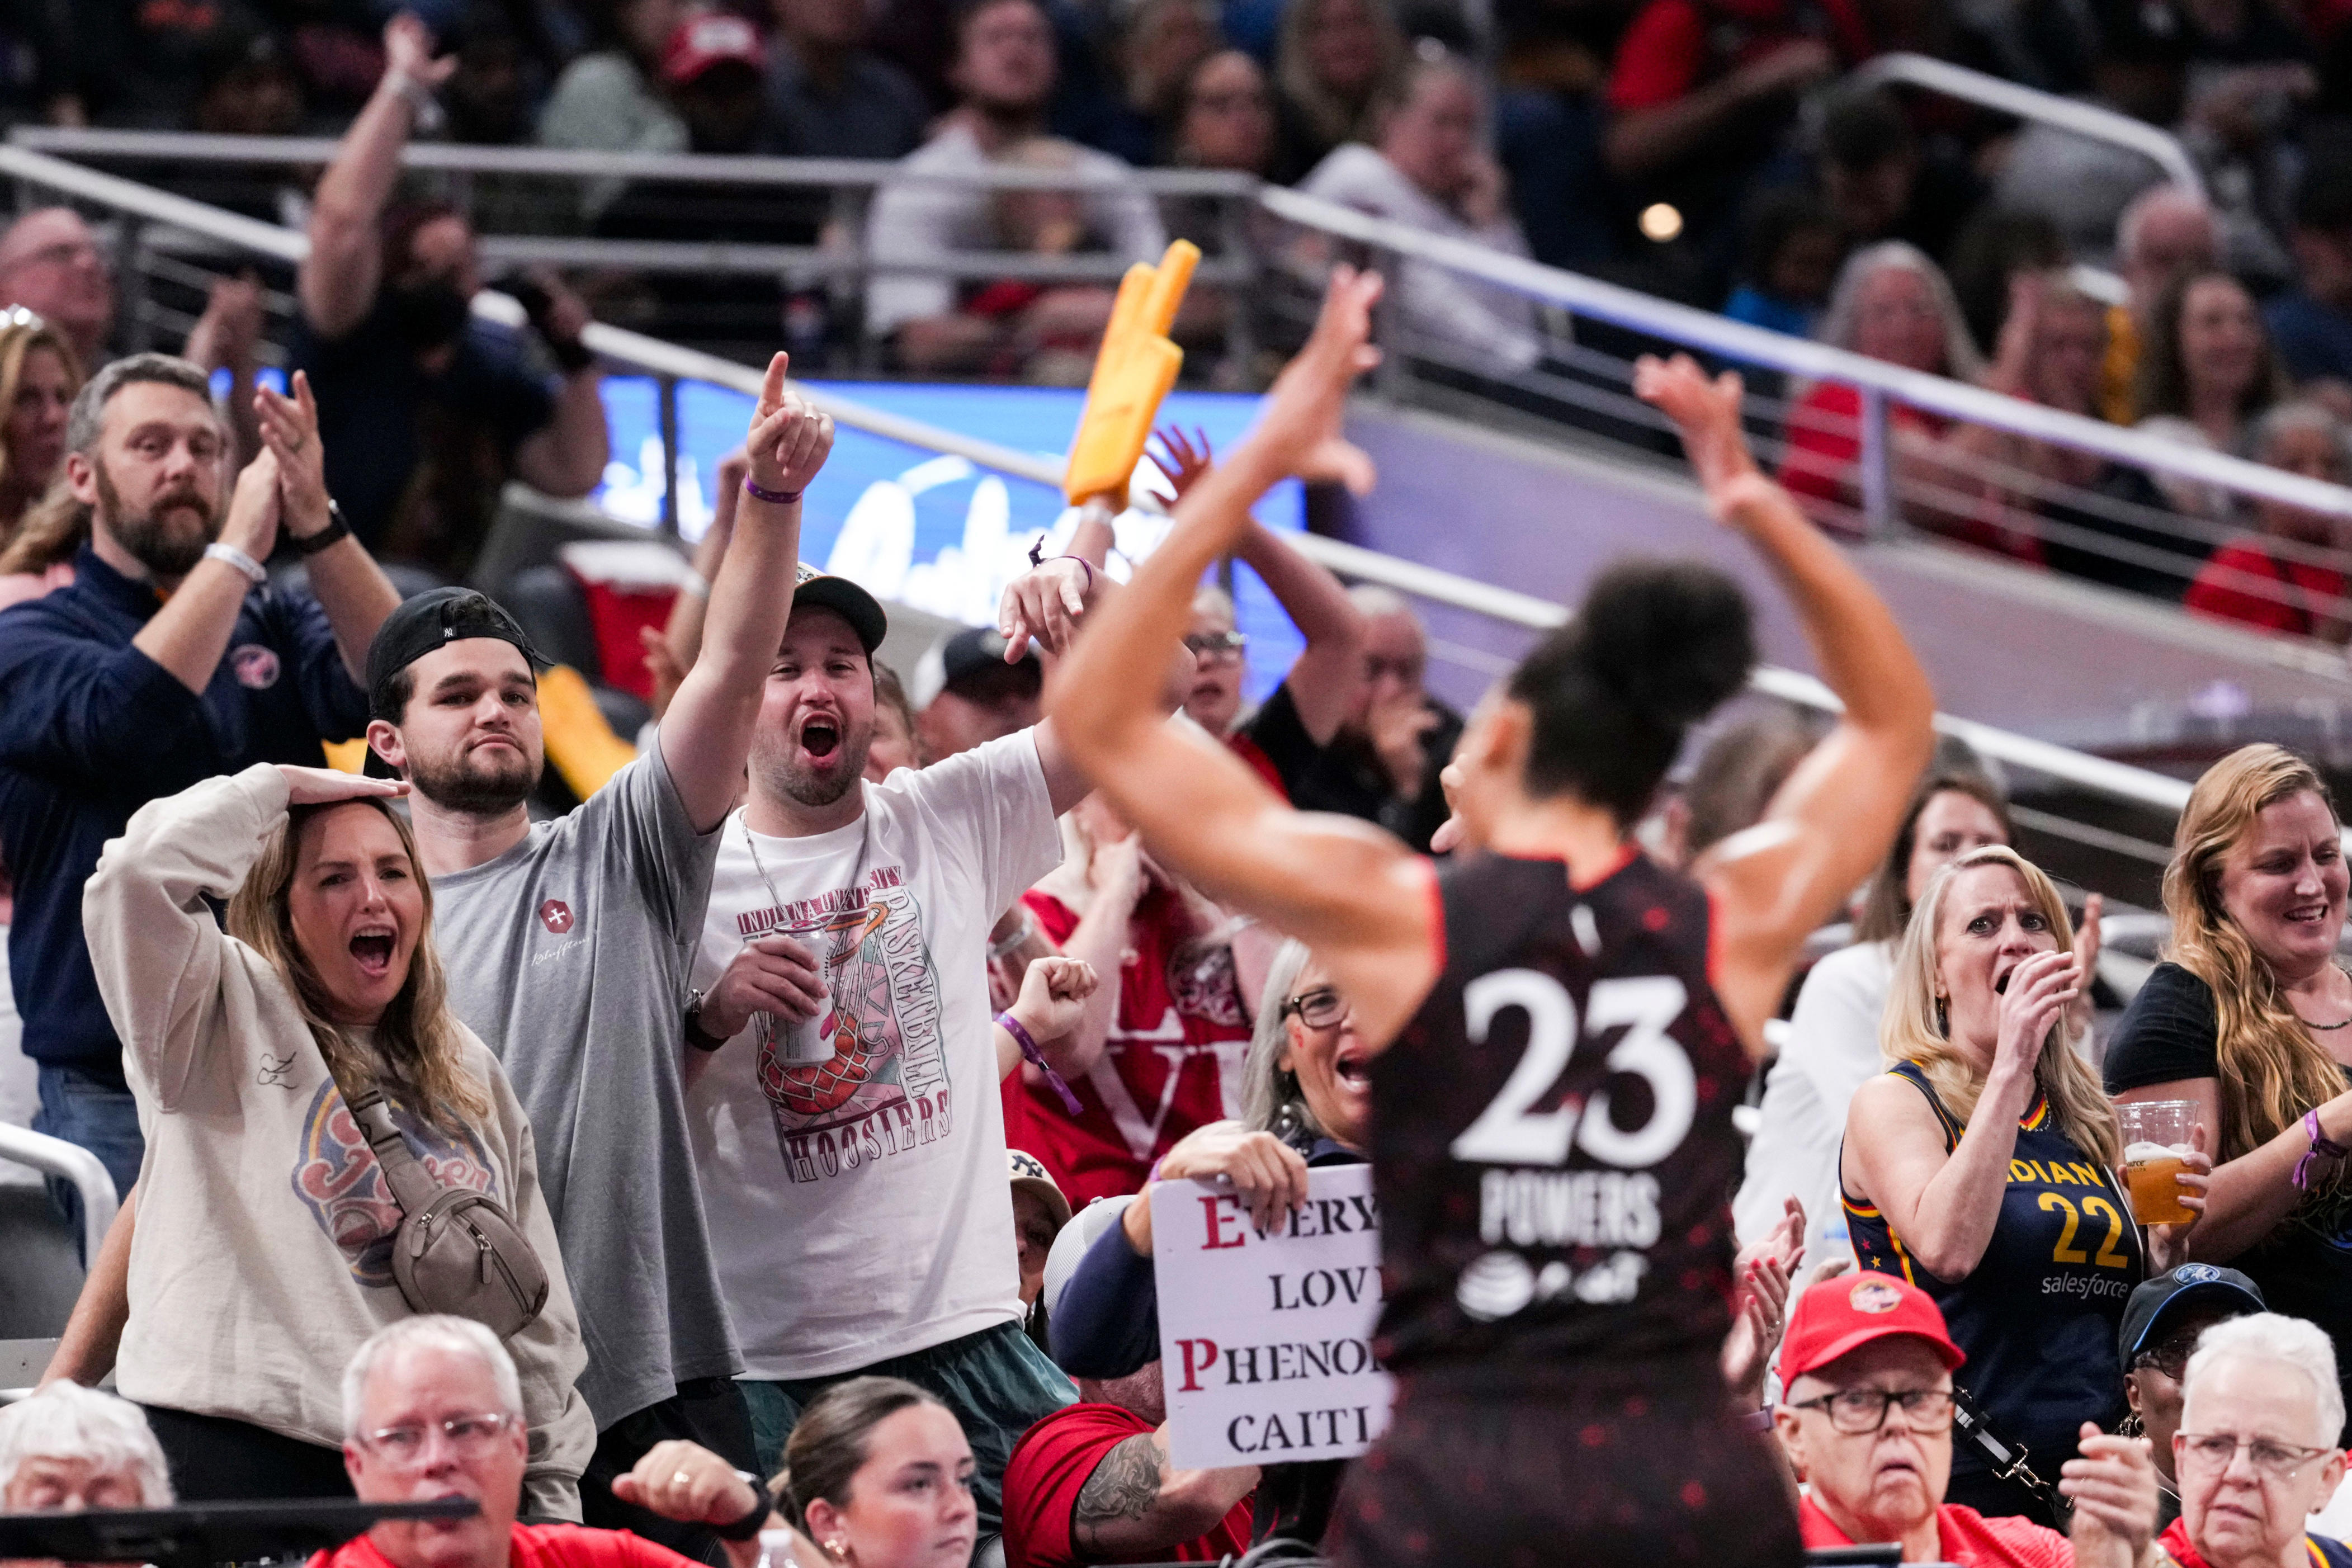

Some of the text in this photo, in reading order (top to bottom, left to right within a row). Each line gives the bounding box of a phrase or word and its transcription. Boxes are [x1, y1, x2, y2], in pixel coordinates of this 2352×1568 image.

[882, 889, 944, 1099] BASKETBALL
[1449, 968, 1698, 1168] 23
[787, 1089, 951, 1183] HOOSIERS
[1012, 1155, 1043, 1178] NY
[2006, 1159, 2105, 1187] DIAN
[1198, 1194, 1378, 1250] EERY
[1479, 1170, 1661, 1247] POWERS
[2038, 1192, 2128, 1269] 22
[2042, 1272, 2128, 1300] salesforce
[1175, 1339, 1385, 1393] PHENO
